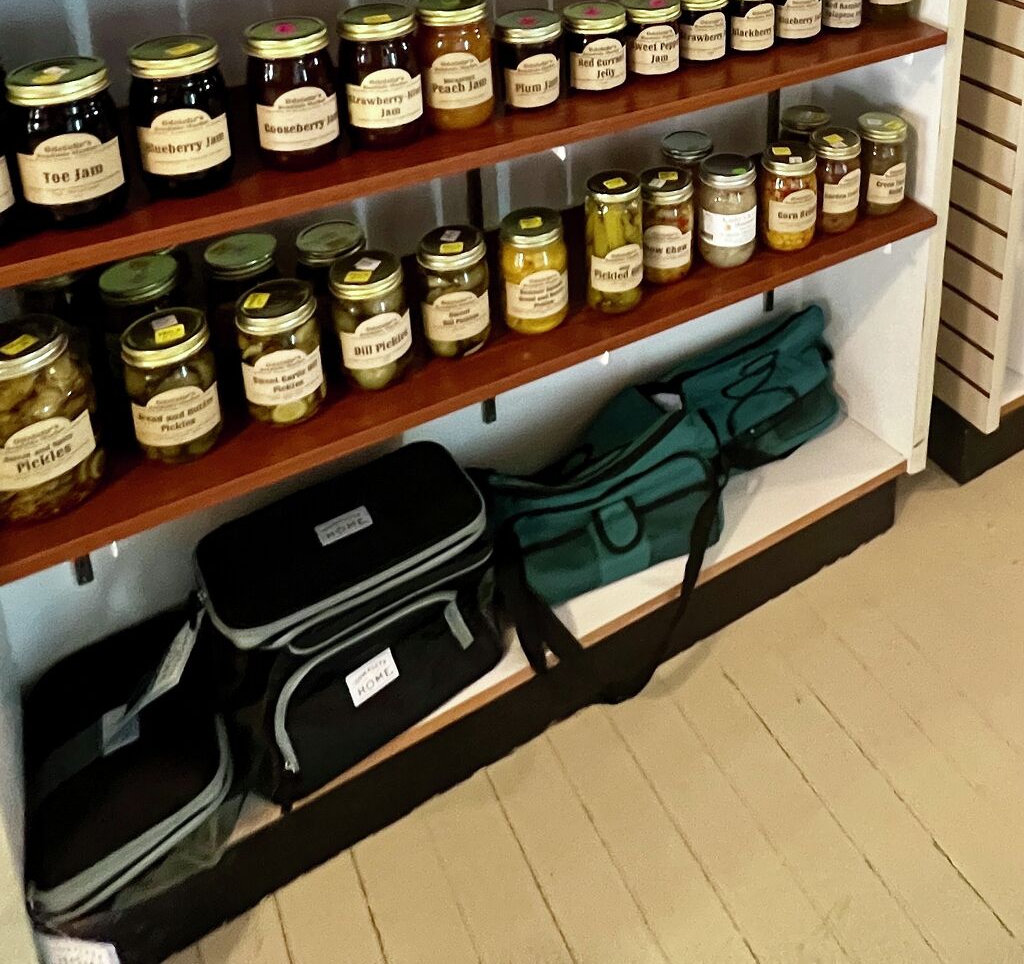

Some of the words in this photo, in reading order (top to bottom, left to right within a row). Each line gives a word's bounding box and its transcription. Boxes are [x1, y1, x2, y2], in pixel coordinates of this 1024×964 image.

[578, 57, 595, 67] Red
[650, 53, 669, 64] Jam
[597, 68, 616, 78] Jelly
[432, 83, 466, 94] Peach
[467, 77, 487, 91] Jam
[514, 83, 542, 93] Plum
[380, 106, 401, 117] Jam
[264, 119, 325, 134] Gooseberry
[43, 171, 70, 184] Toe
[74, 163, 104, 182] Jam
[777, 210, 799, 220] Corn
[353, 344, 373, 356] Dill
[375, 327, 409, 353] Pickles
[160, 417, 196, 432] Pickles
[16, 443, 72, 474] Pickles
[357, 667, 394, 697] HOME
